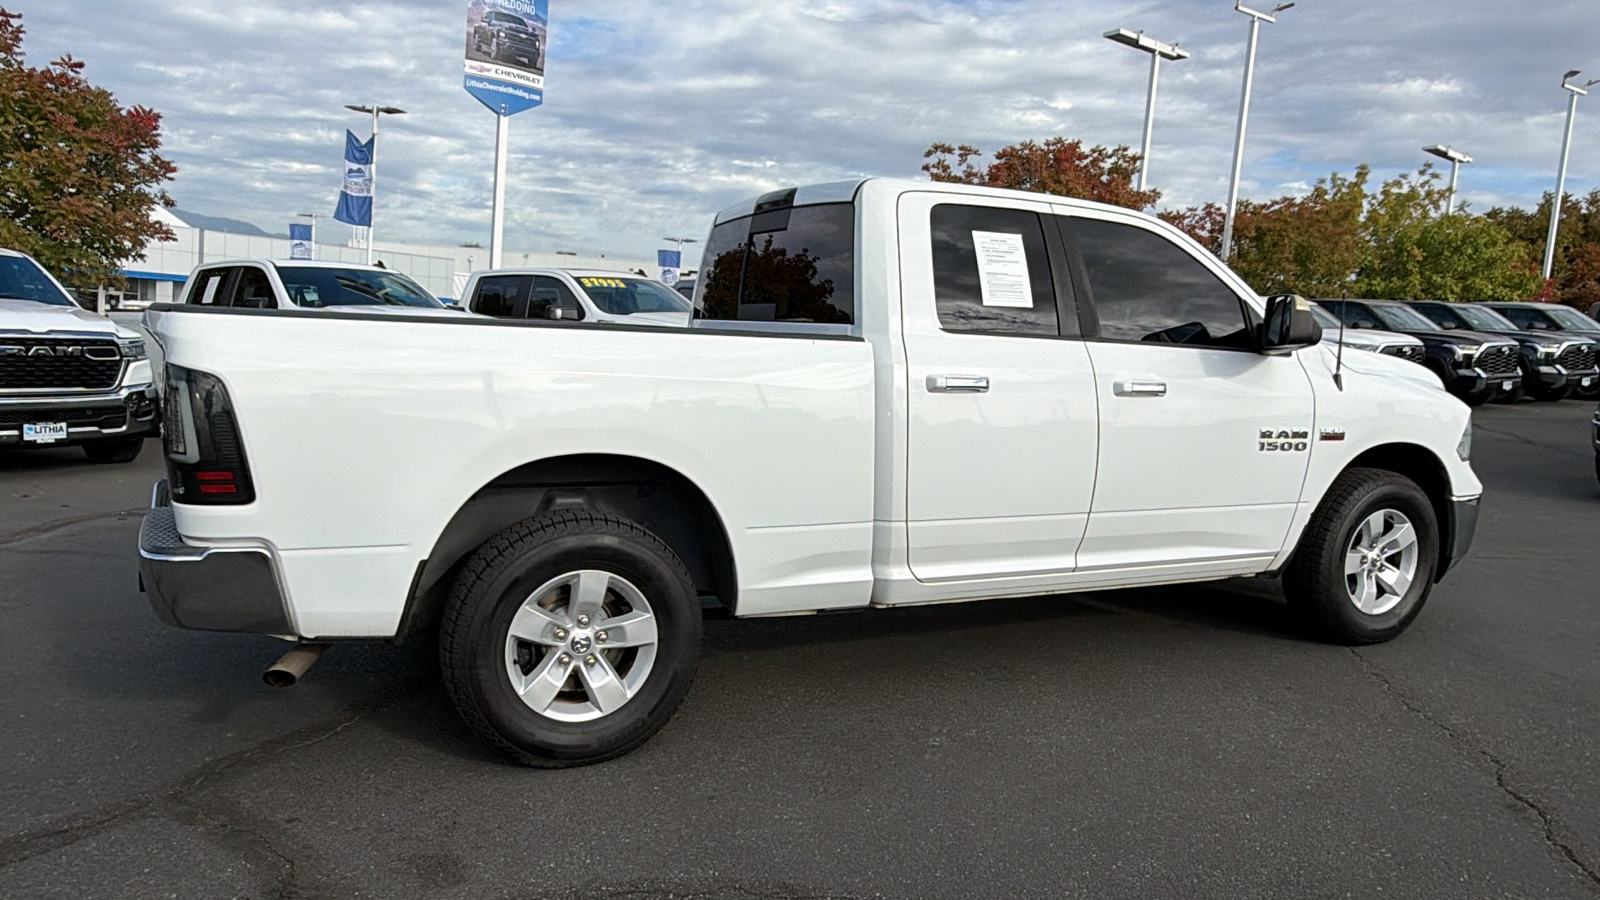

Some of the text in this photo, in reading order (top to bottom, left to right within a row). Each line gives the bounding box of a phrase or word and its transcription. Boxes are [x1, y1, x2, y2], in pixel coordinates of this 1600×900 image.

[498, 0, 536, 15] REDDING
[495, 68, 541, 84] CHEVROLET
[466, 78, 541, 101] LithiaChevroletRedding.com
[0, 345, 82, 356] RAM
[34, 425, 64, 434] LITHIA
[1259, 428, 1309, 439] RAM
[1258, 441, 1308, 451] 1500
